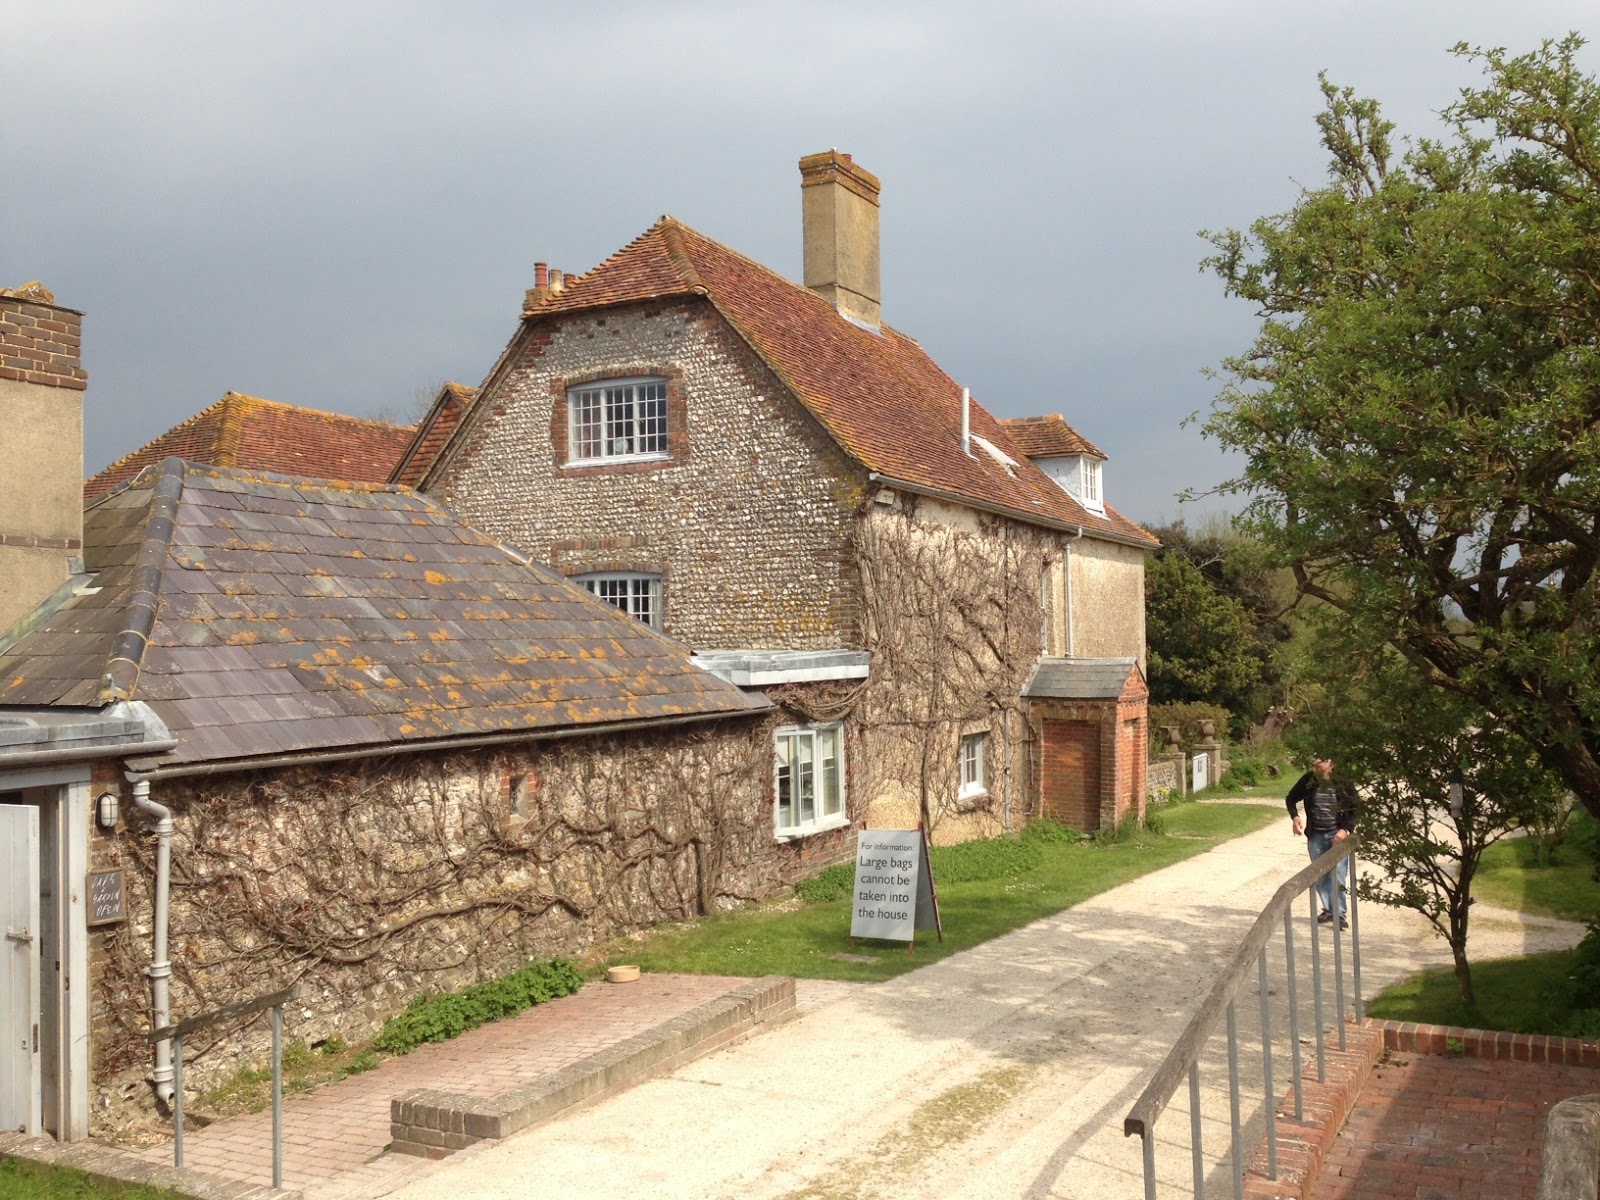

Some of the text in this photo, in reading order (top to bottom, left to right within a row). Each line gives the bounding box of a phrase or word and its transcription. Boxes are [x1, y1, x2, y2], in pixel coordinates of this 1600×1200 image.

[861, 842, 873, 850] For
[860, 856, 913, 871] Large bags
[861, 874, 910, 886] cannot be
[859, 890, 910, 903] taken into
[96, 901, 120, 917] OPEN
[858, 907, 908, 920] the house
